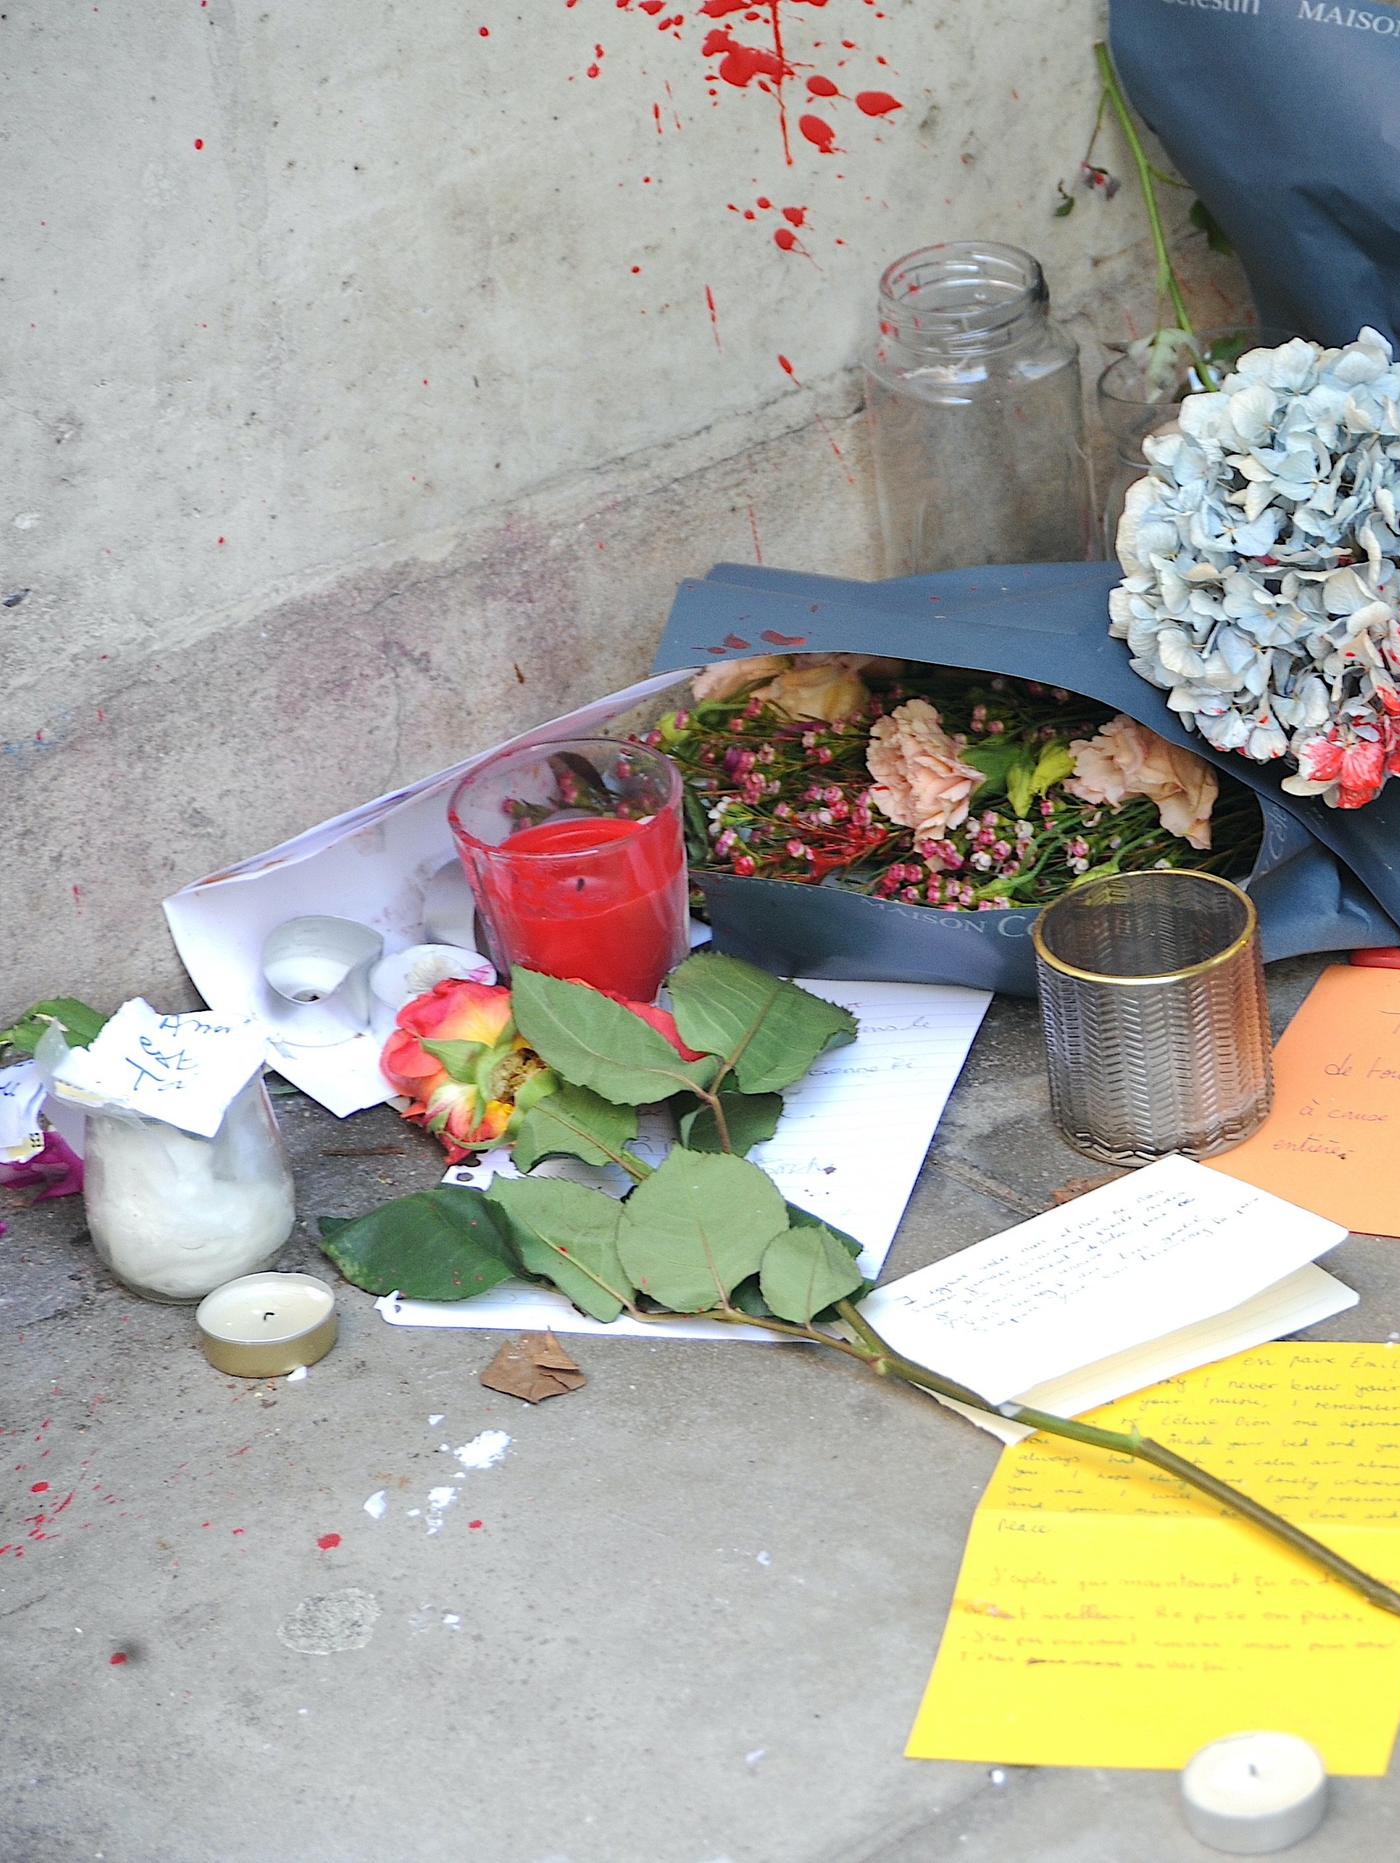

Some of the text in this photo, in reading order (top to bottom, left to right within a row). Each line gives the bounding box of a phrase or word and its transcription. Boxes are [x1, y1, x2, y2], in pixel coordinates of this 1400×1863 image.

[1323, 1053, 1353, 1077] de
[1327, 1108, 1389, 1123] cause
[1289, 1355, 1336, 1368] paix
